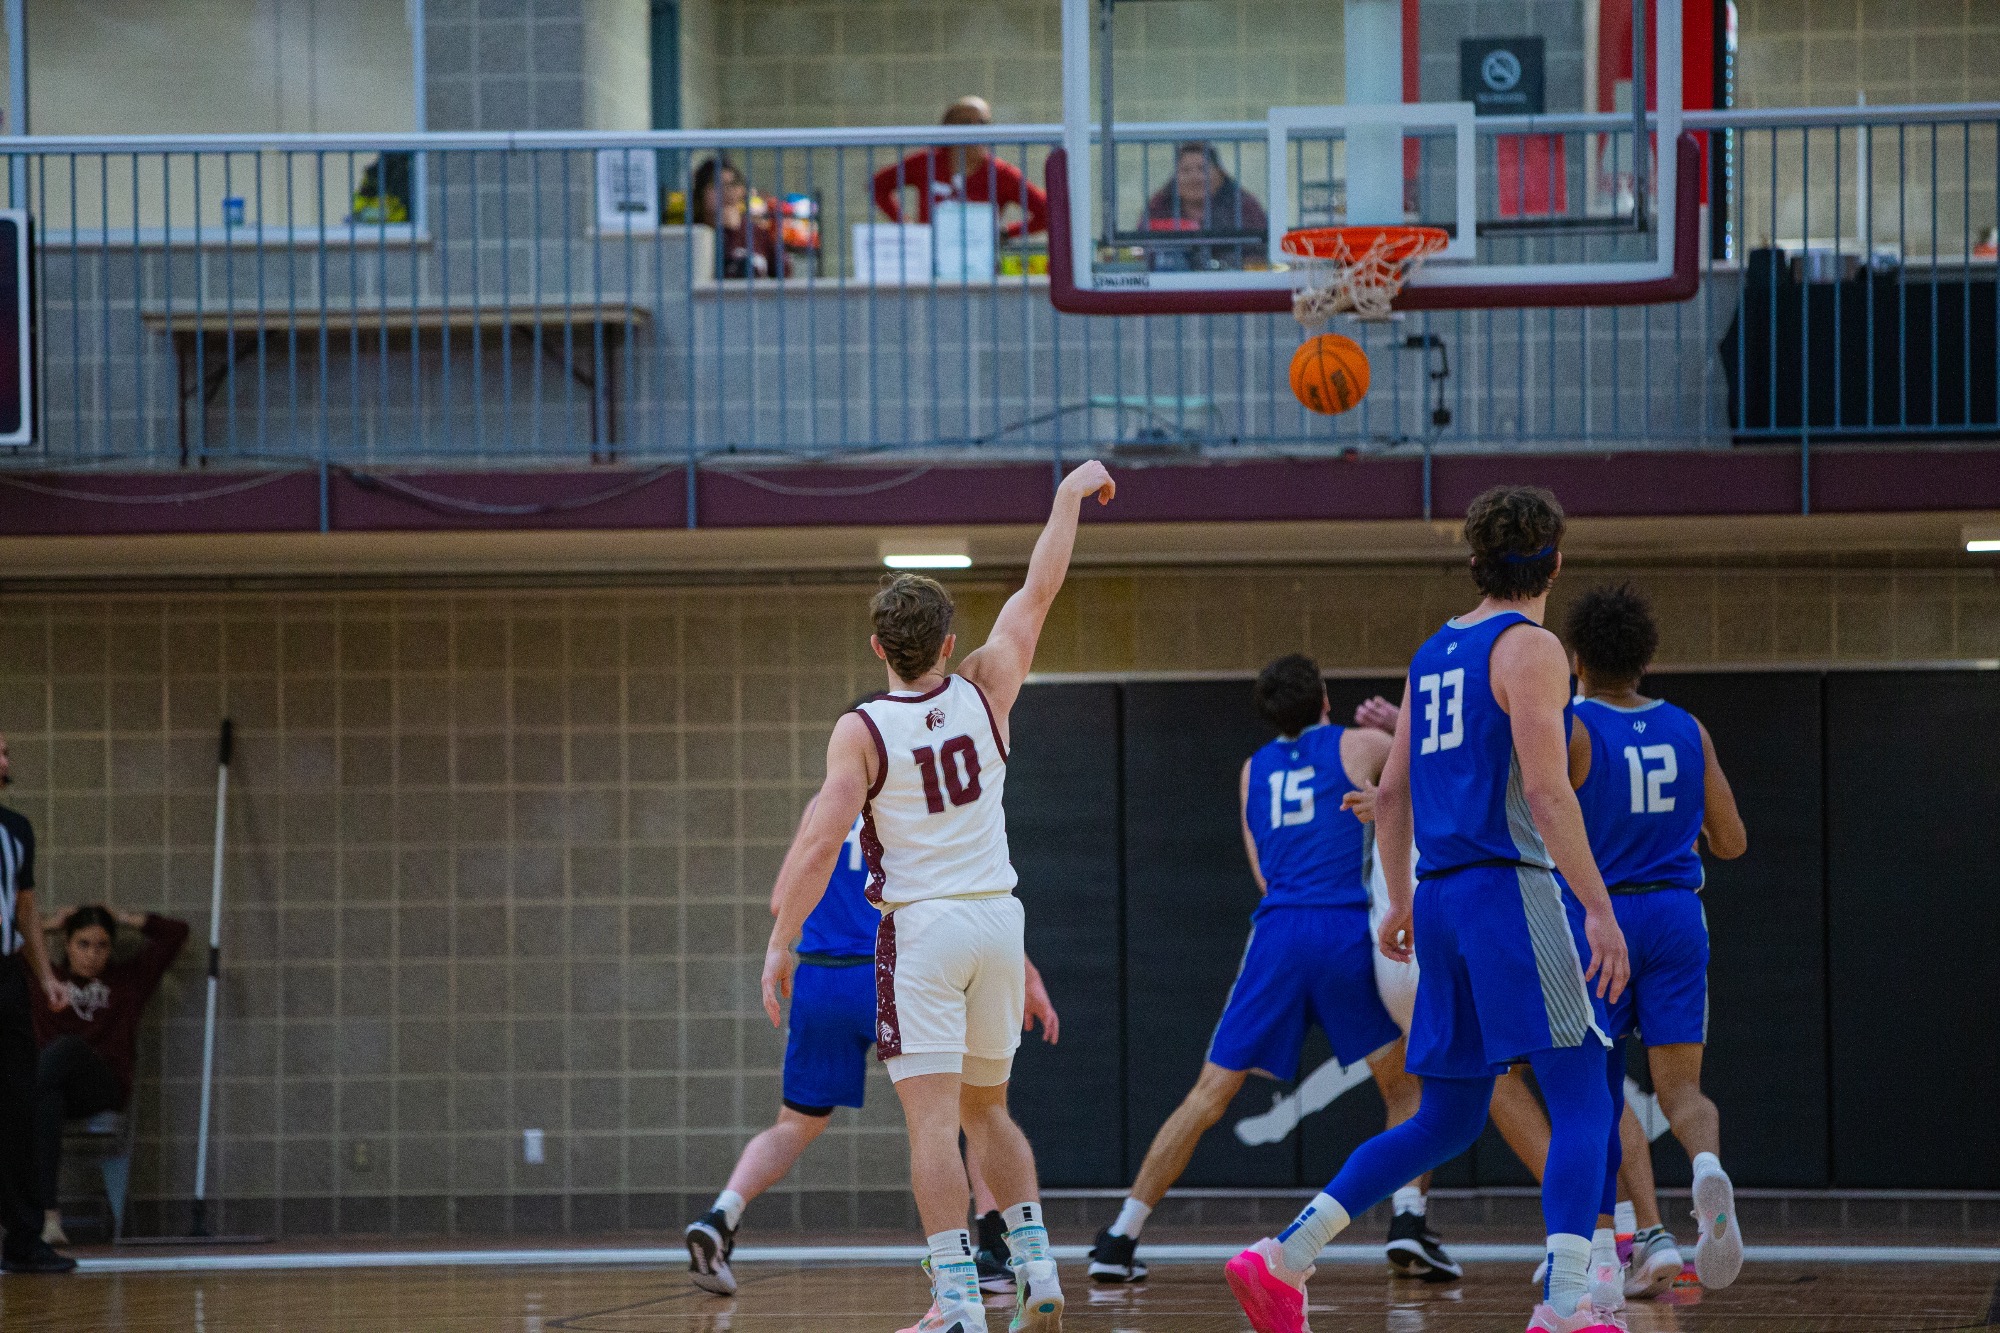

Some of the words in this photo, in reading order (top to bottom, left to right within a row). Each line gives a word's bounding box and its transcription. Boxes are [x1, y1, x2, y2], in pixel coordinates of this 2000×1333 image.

[1419, 667, 1464, 756] 33
[911, 733, 982, 815] 10
[1268, 765, 1316, 830] 15
[1624, 743, 1678, 813] 12
